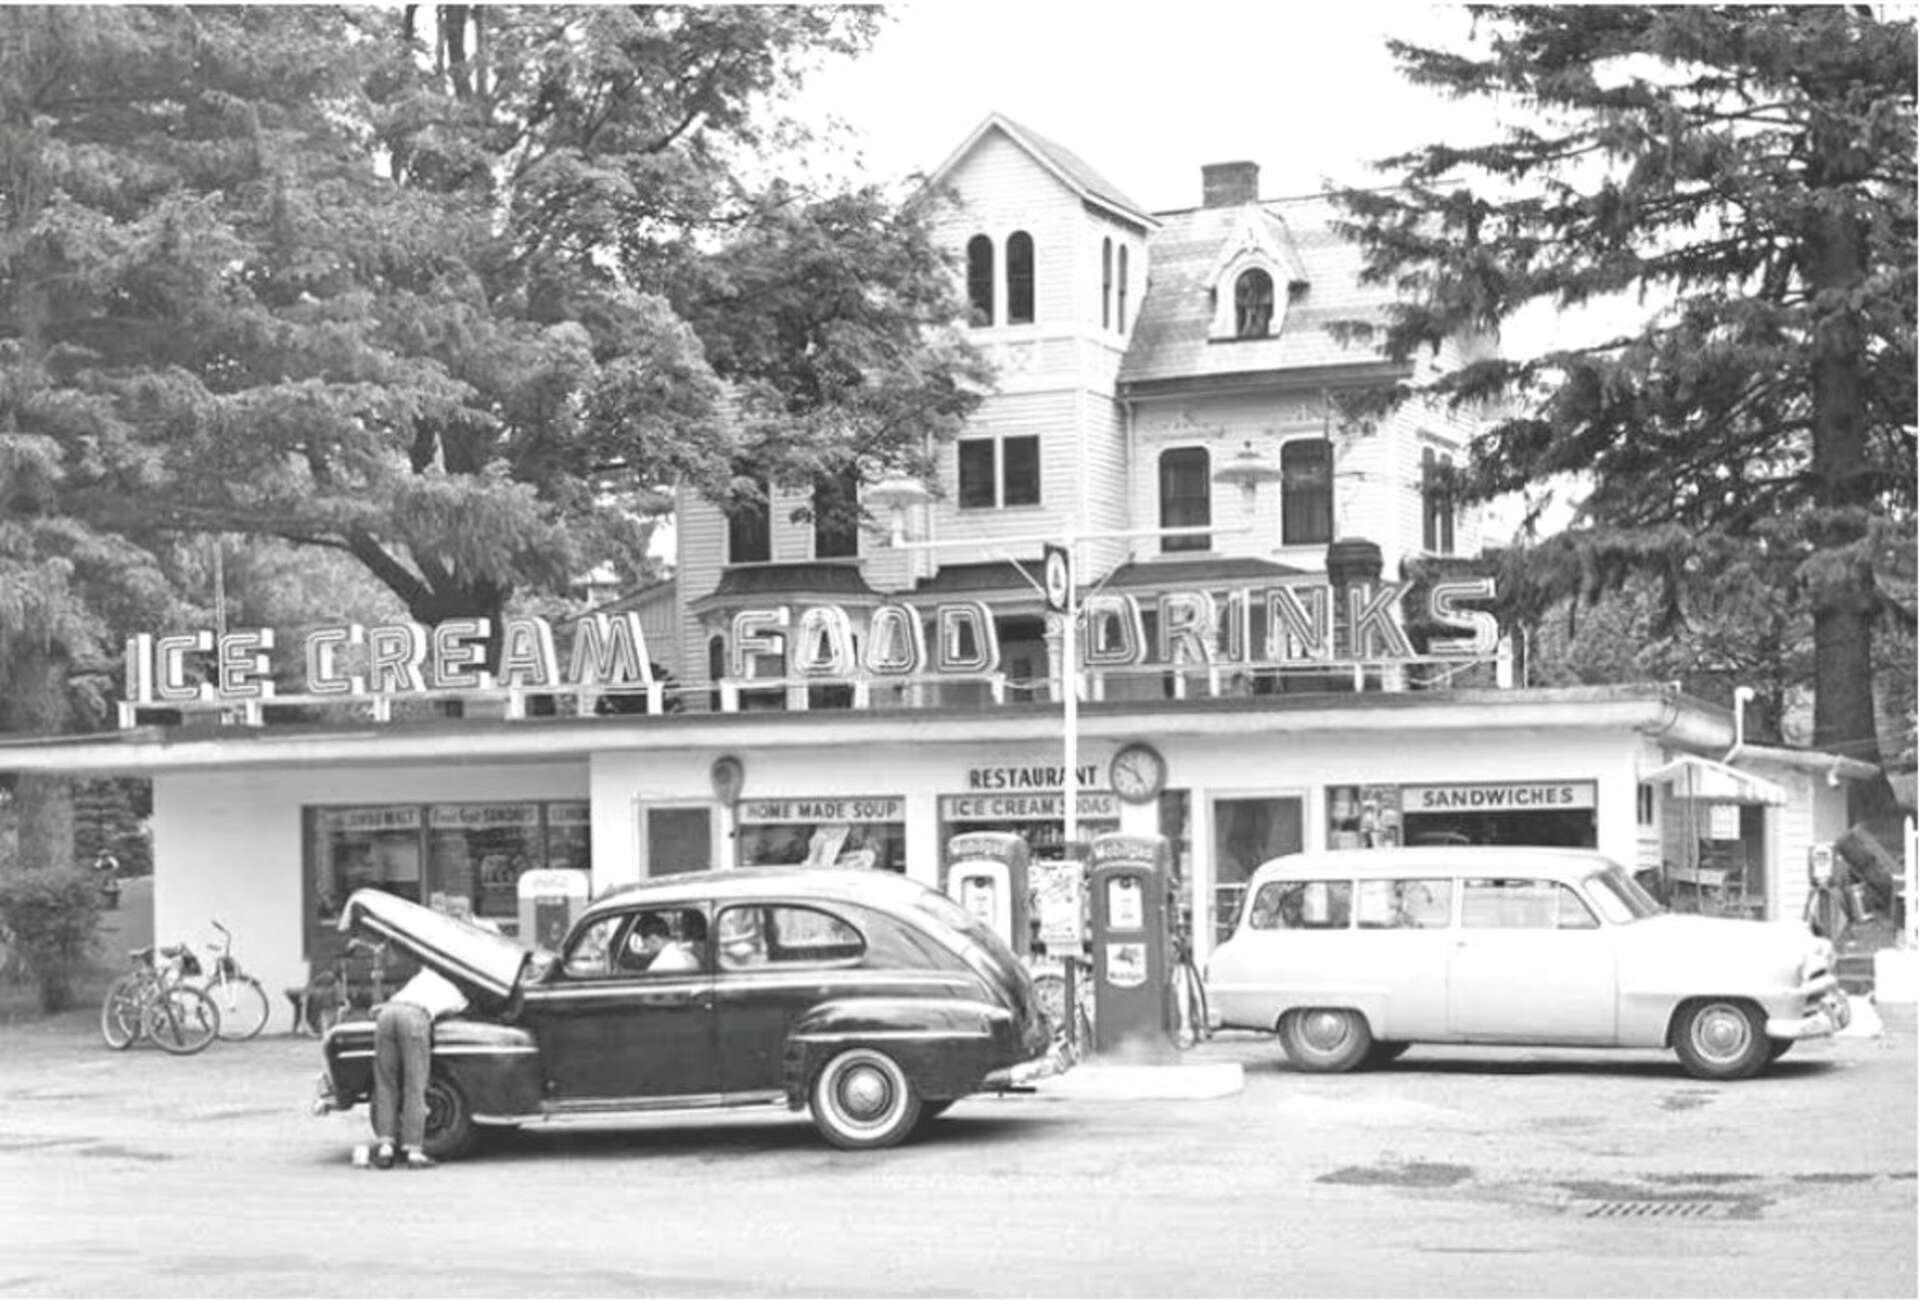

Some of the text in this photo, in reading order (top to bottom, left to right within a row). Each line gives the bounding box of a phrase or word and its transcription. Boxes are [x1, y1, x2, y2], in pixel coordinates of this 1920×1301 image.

[730, 601, 1003, 677] FOOD
[1081, 578, 1499, 665] DRINKS
[126, 611, 652, 700] ICE CREAM
[748, 801, 897, 819] HOME MADE SOUP
[952, 801, 985, 815] ICE
[992, 799, 1054, 815] CREAM
[1422, 786, 1574, 807] SANDWICHES
